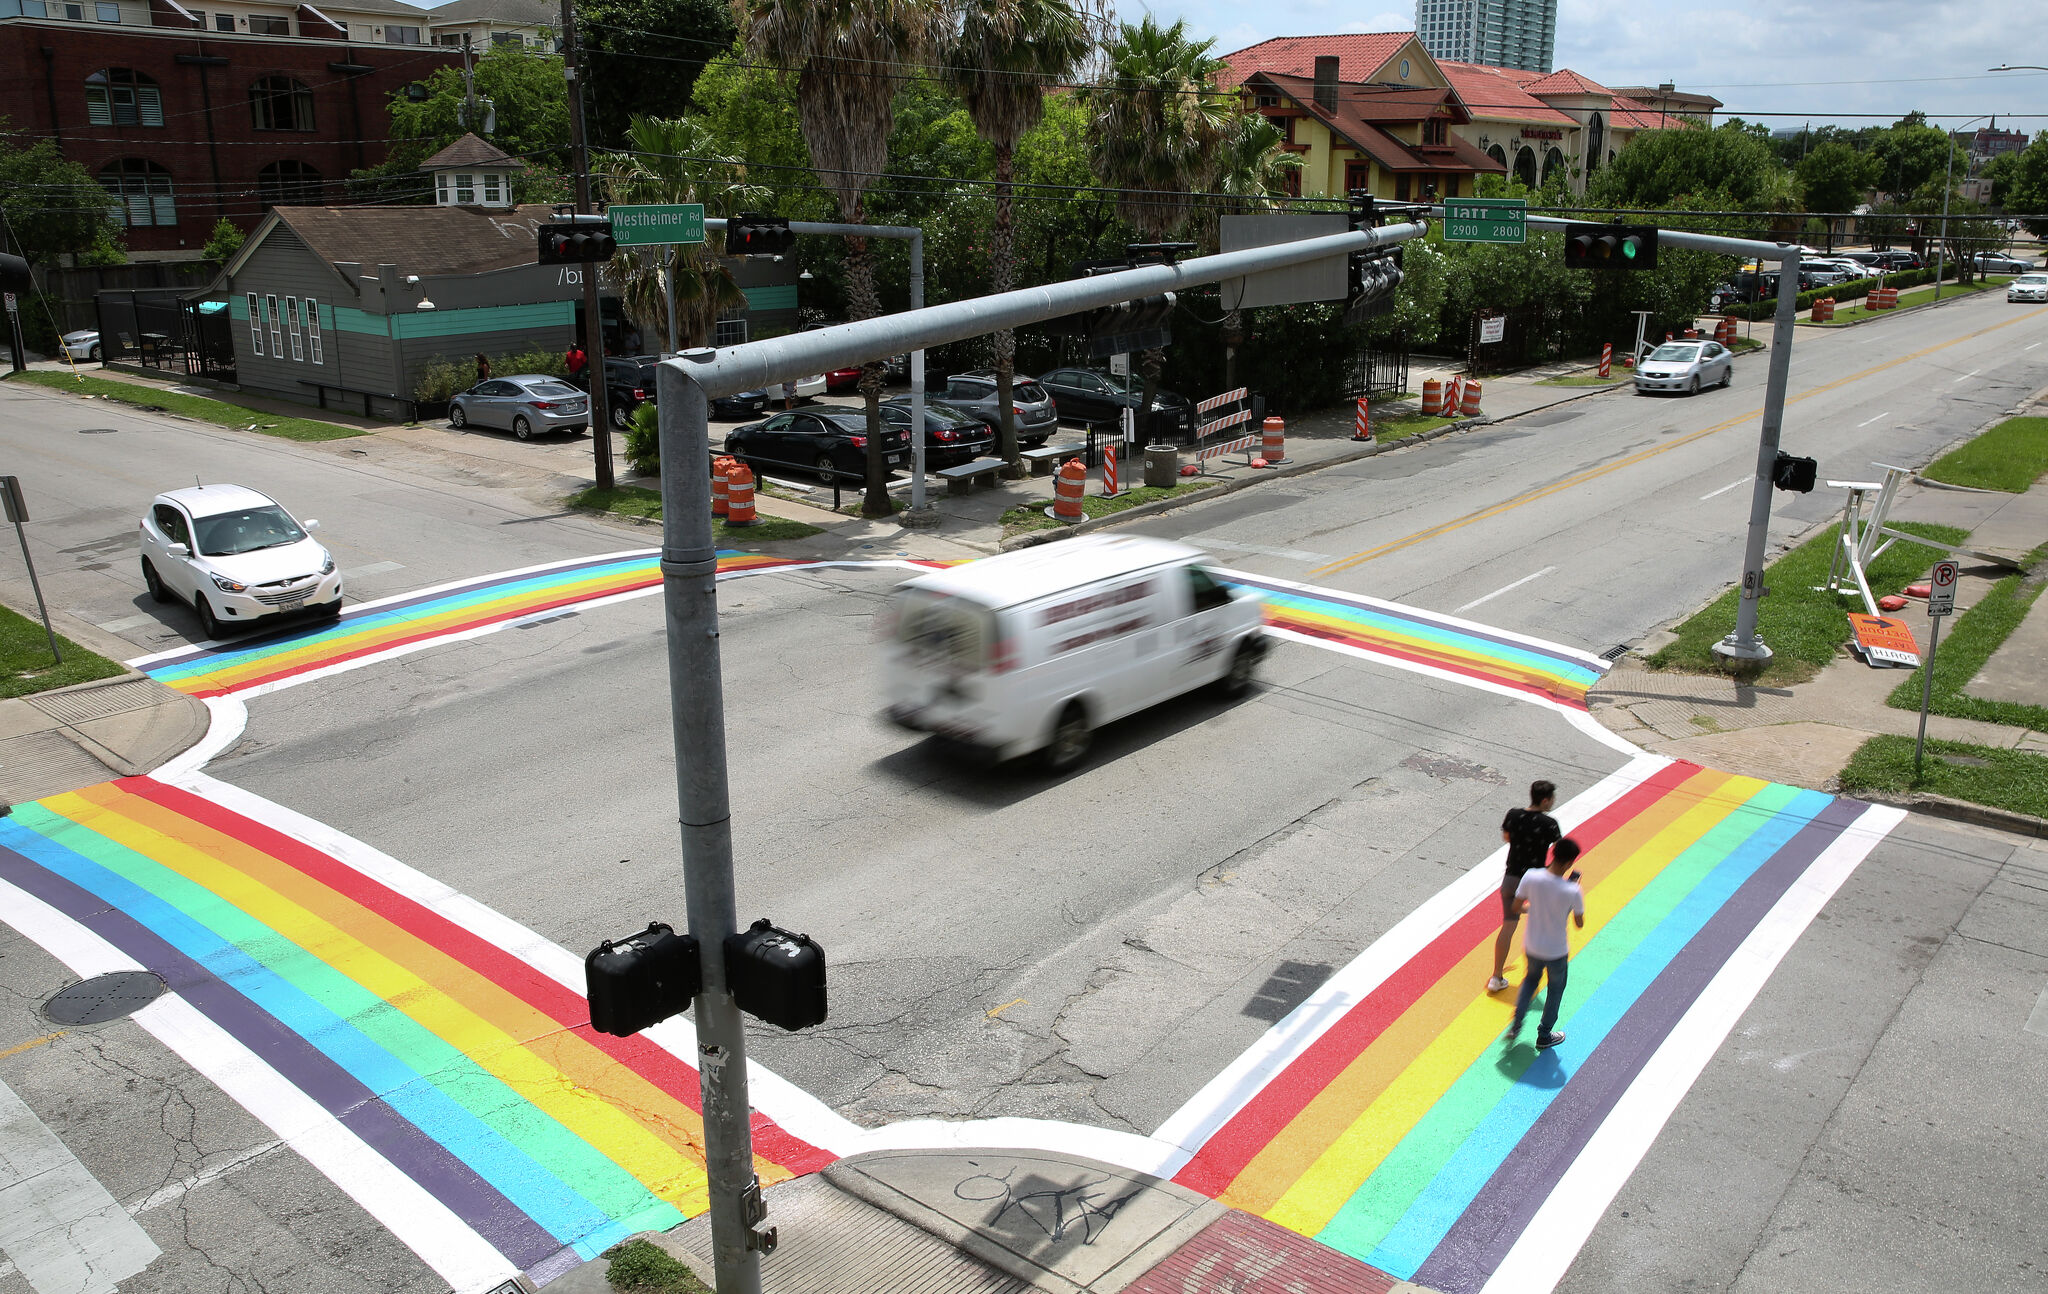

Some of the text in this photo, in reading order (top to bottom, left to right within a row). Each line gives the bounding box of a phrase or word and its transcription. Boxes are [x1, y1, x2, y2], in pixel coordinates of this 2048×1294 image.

[613, 210, 700, 227] Westheimer Rd
[1508, 208, 1521, 219] St
[613, 228, 701, 240] 300 400
[1452, 225, 1520, 237] 2900 2800
[1874, 648, 1916, 662] SOUTH
